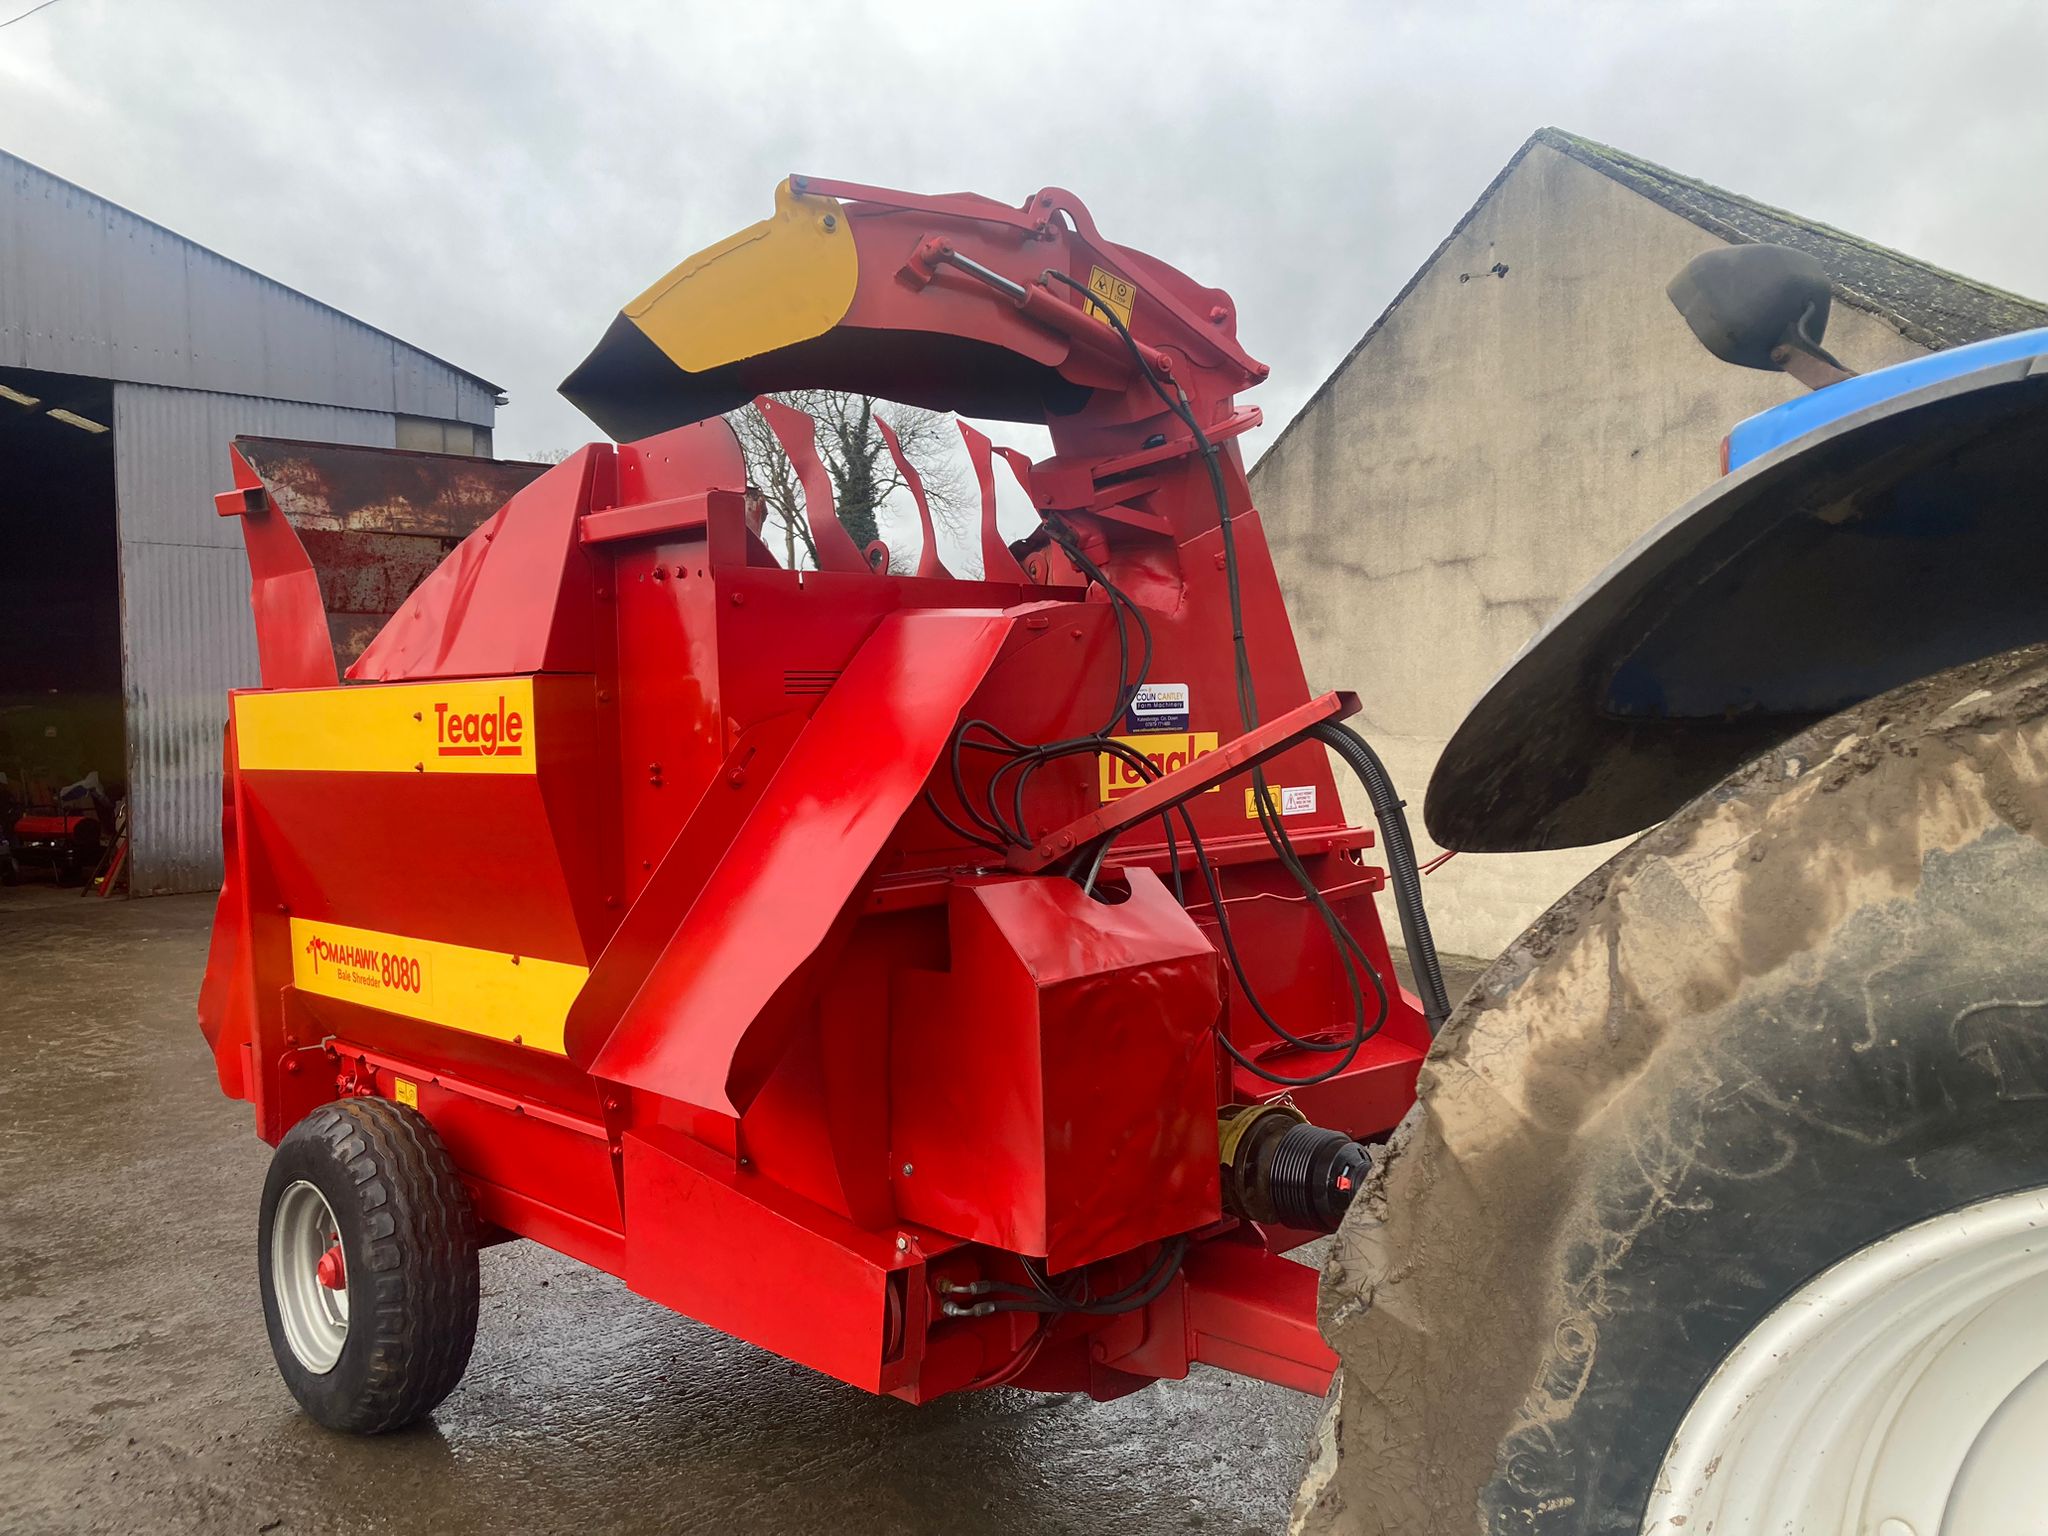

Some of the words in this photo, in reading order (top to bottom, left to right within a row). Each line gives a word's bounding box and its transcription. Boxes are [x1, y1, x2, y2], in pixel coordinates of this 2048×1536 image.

[1136, 692, 1156, 701] COLIN
[1157, 692, 1184, 701] CANTLEY
[434, 696, 523, 756] Teagle
[337, 968, 351, 981] Bale
[352, 971, 381, 988] Shredder
[381, 952, 421, 994] 8080
